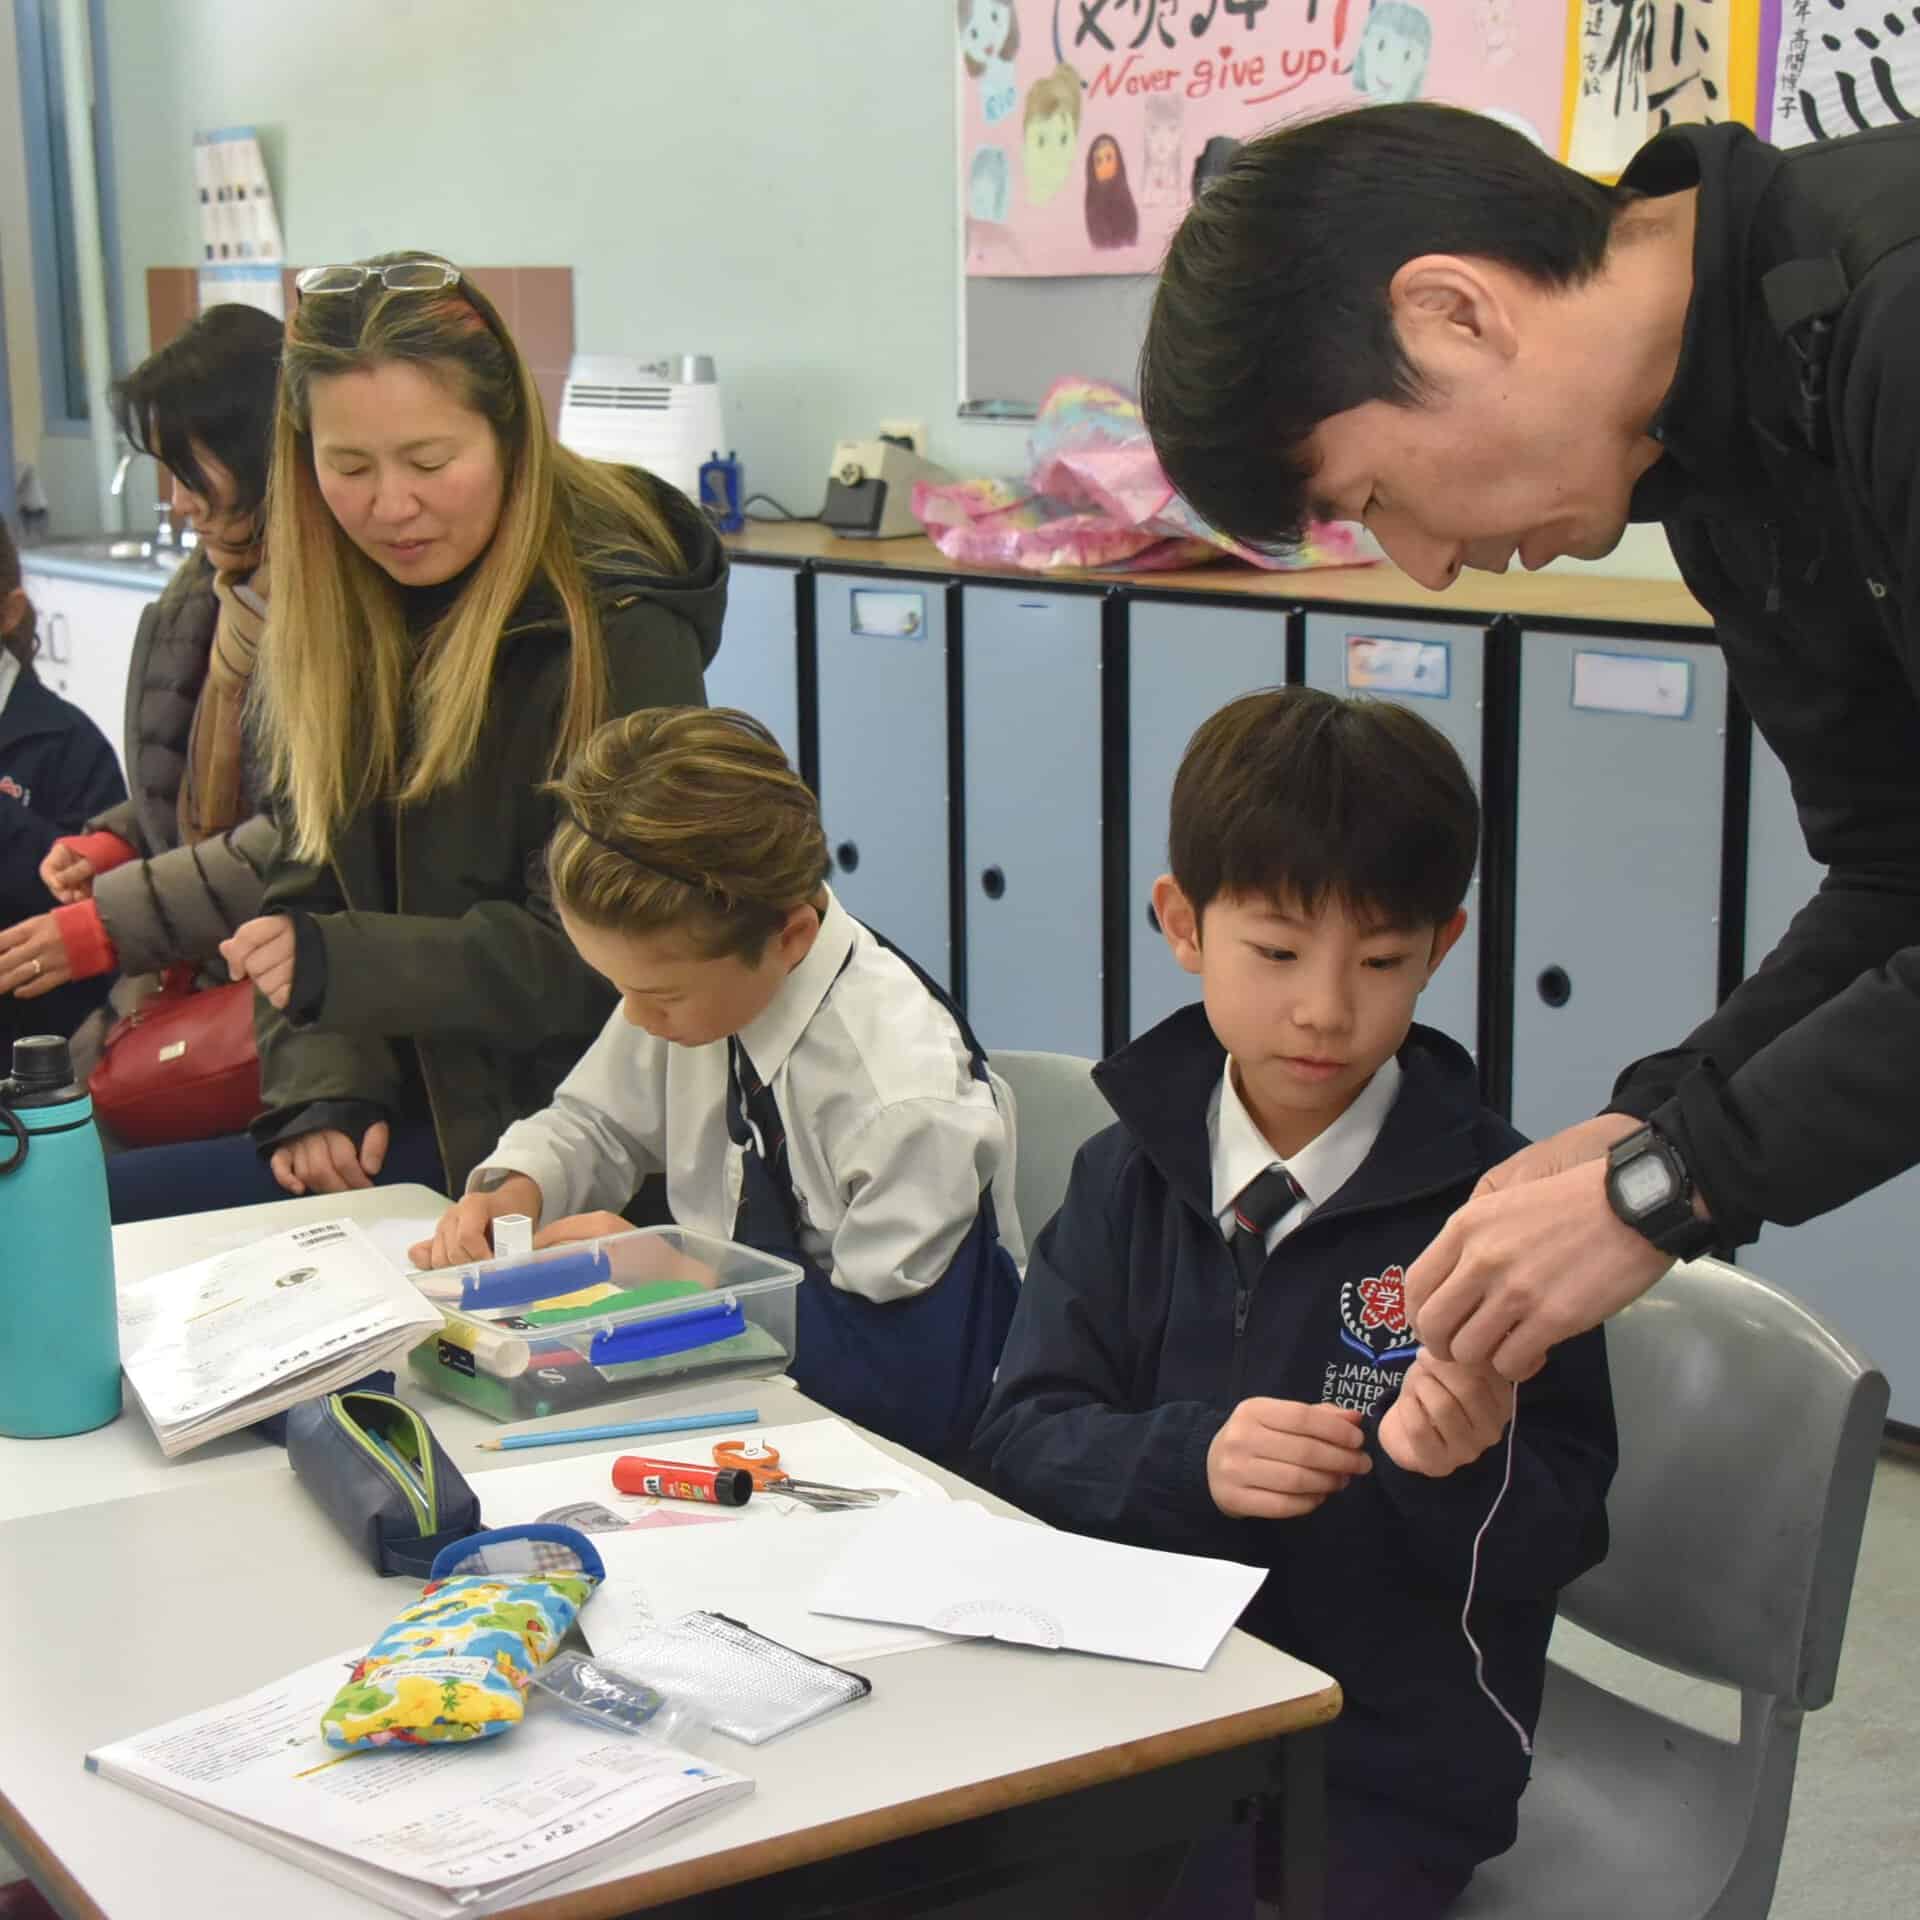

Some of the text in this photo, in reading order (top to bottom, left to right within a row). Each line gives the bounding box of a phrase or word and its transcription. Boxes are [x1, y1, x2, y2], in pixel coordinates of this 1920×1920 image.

[1185, 46, 1266, 98] give
[1320, 1361, 1337, 1403] YDNEY
[1338, 1363, 1405, 1387] JAPANE
